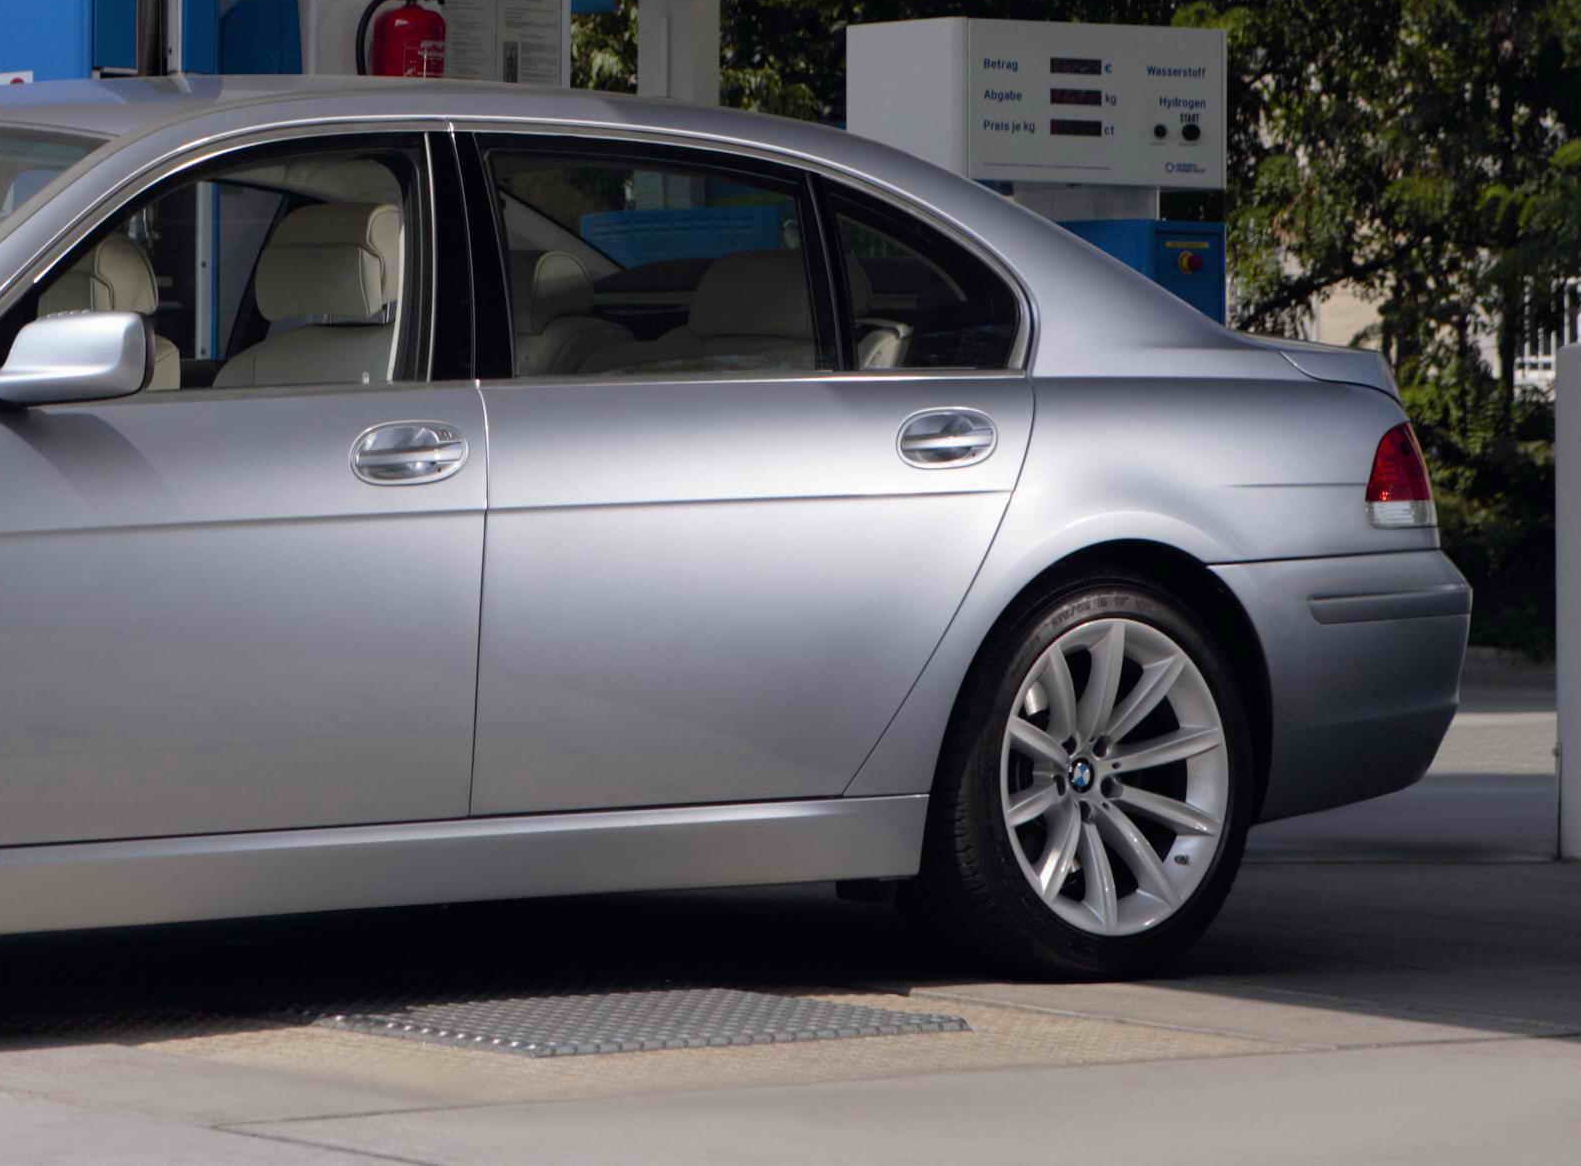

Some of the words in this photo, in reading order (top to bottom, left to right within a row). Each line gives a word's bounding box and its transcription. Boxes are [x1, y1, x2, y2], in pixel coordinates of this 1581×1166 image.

[983, 57, 1018, 72] Betrag
[1104, 63, 1112, 74] €
[1146, 65, 1206, 79] Wasserstoff
[984, 89, 1022, 103] Abgabe
[1105, 93, 1117, 107] kg
[1159, 96, 1206, 110] Hydrogen
[1180, 113, 1199, 123] START
[983, 120, 1009, 132] Preis
[1011, 122, 1021, 134] je
[1023, 121, 1035, 134] kg
